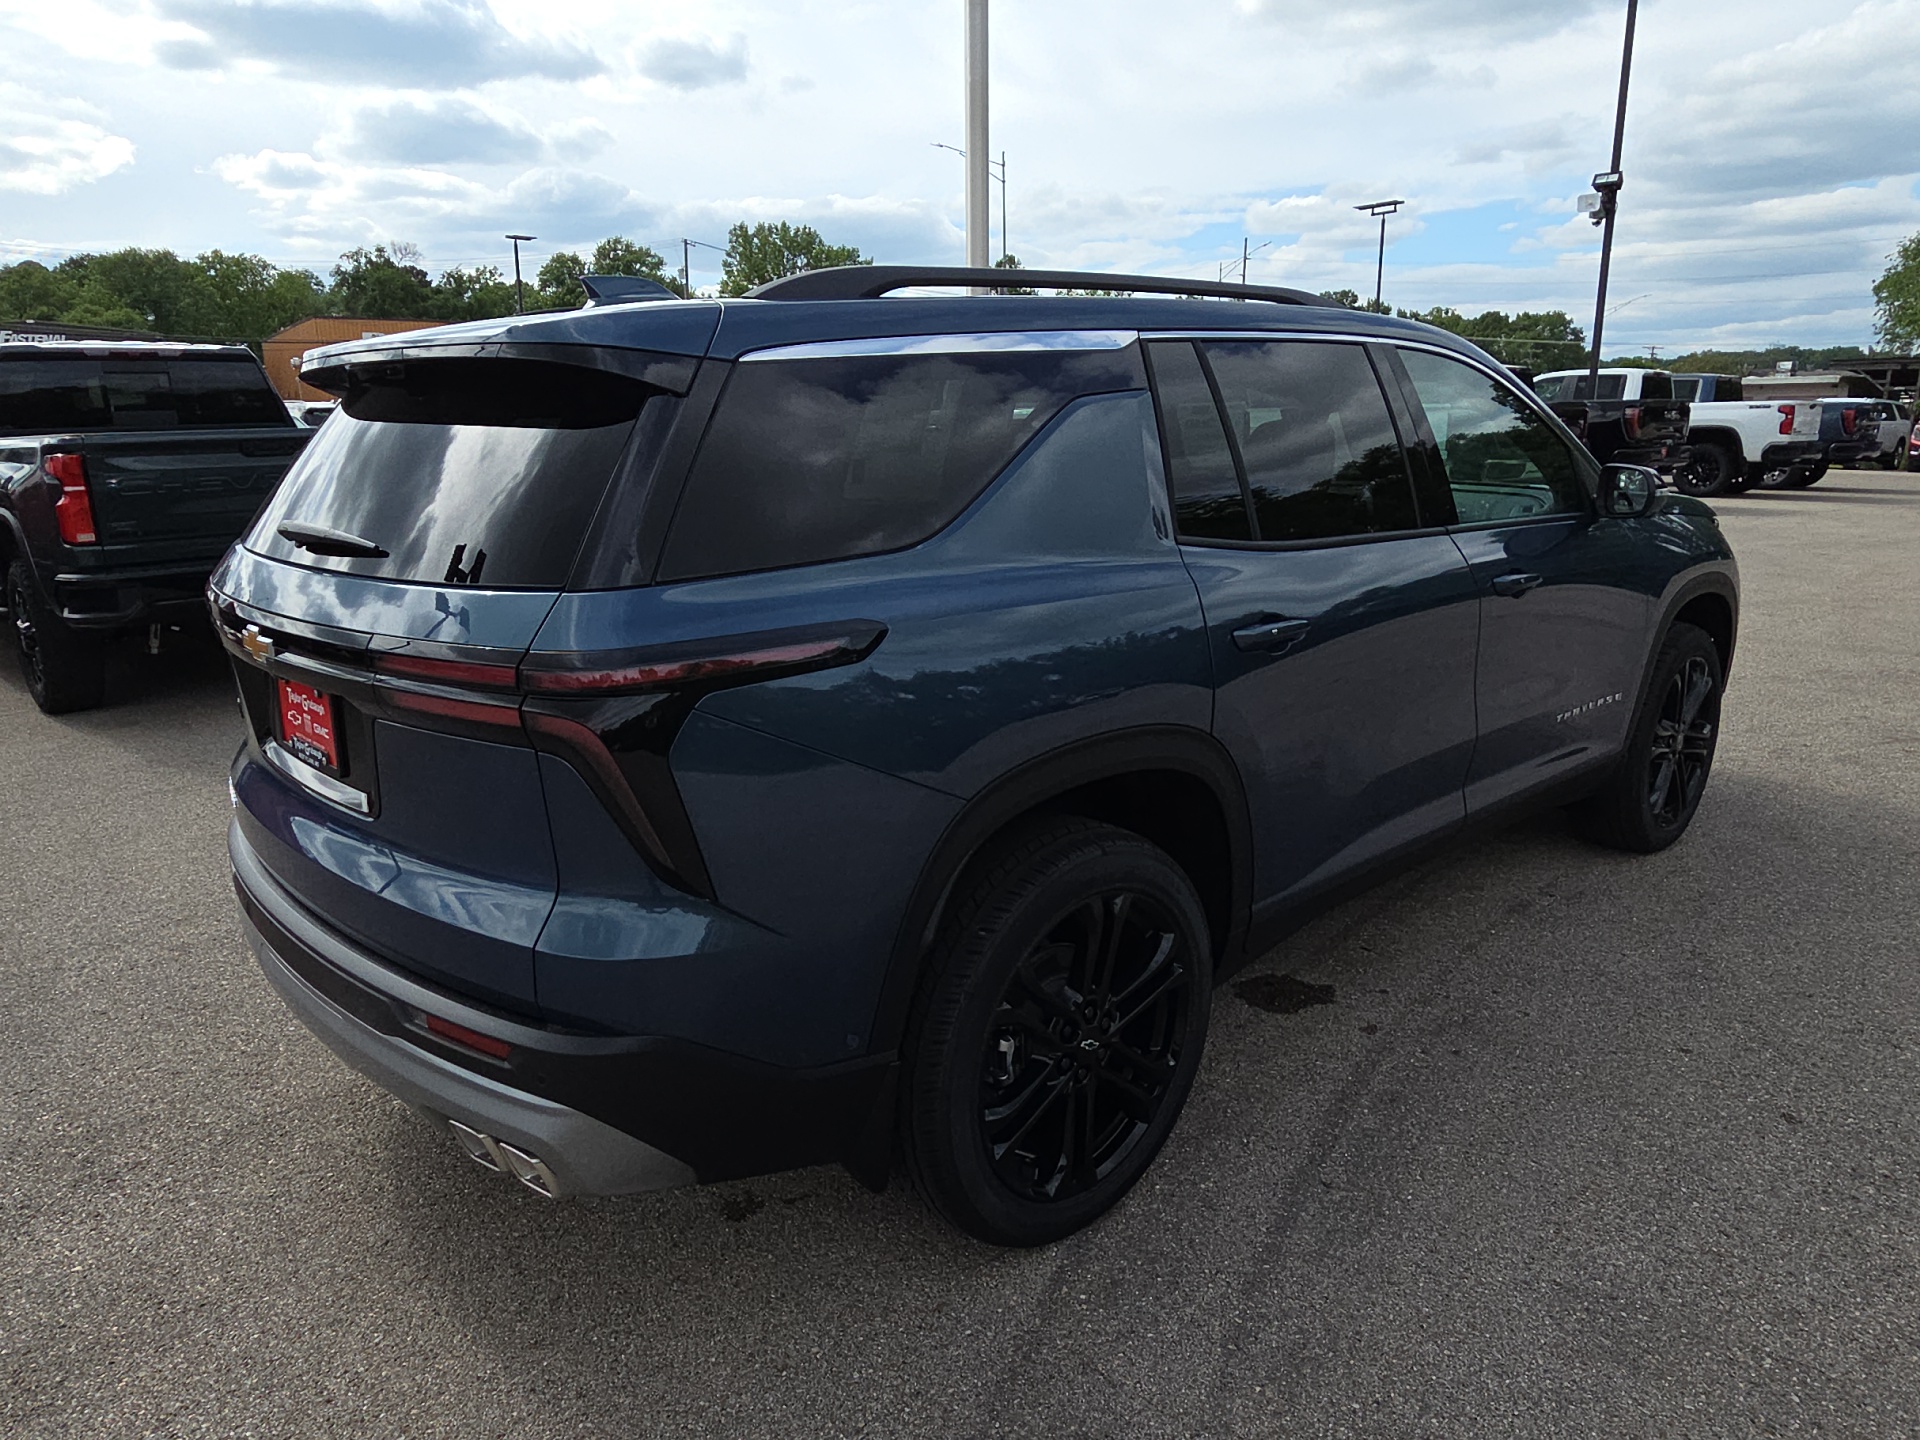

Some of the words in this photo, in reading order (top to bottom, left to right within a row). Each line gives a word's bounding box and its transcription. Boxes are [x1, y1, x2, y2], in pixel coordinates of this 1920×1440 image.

[0, 330, 66, 342] FASTENAL
[1556, 692, 1623, 722] TRAVERSE
[313, 723, 330, 739] GMC
